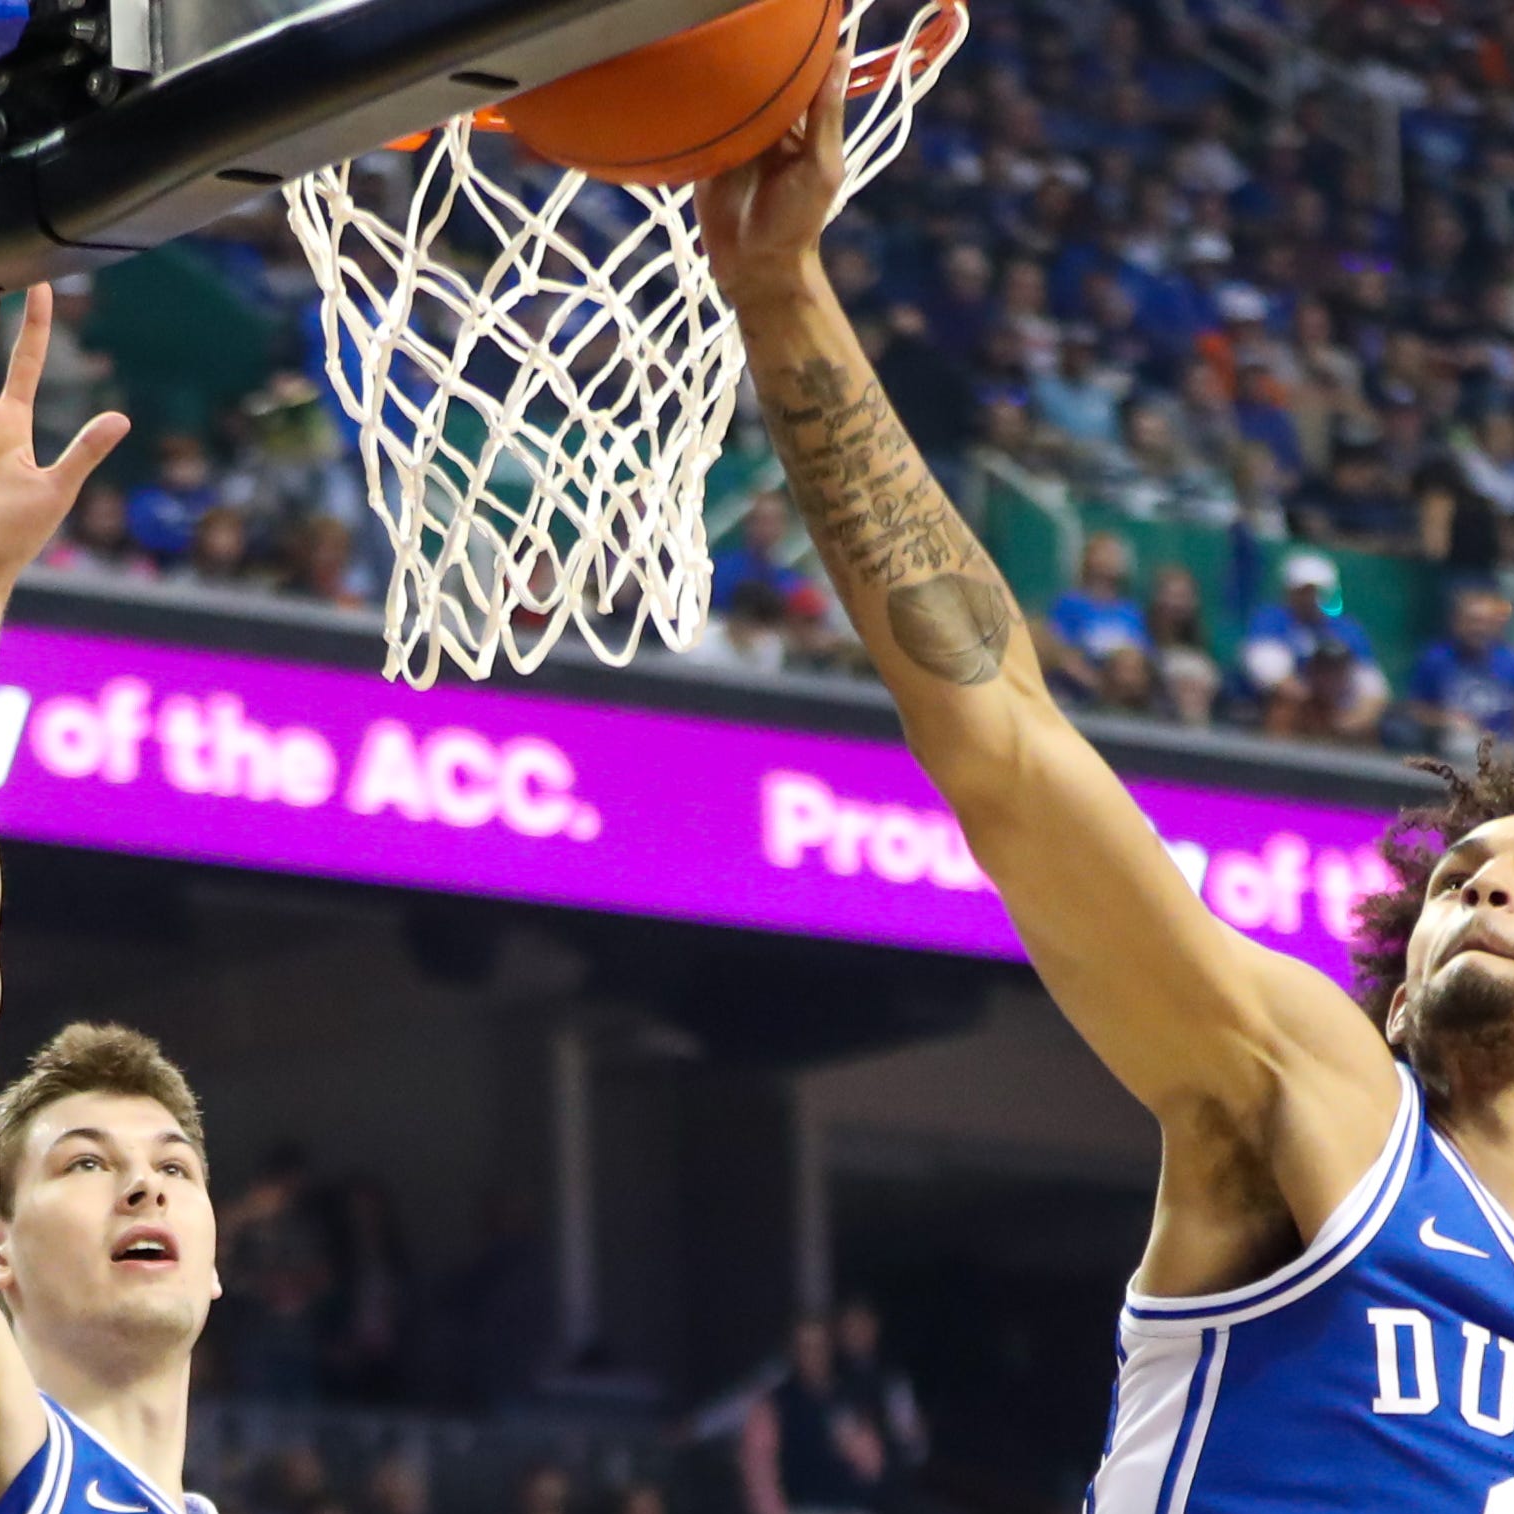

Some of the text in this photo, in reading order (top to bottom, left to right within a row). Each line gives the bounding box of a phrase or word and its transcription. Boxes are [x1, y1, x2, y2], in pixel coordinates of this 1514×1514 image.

[29, 676, 153, 785] of
[156, 690, 337, 807] the
[345, 719, 602, 842] ACC.
[760, 768, 1001, 892] Prou
[1204, 832, 1311, 934] of
